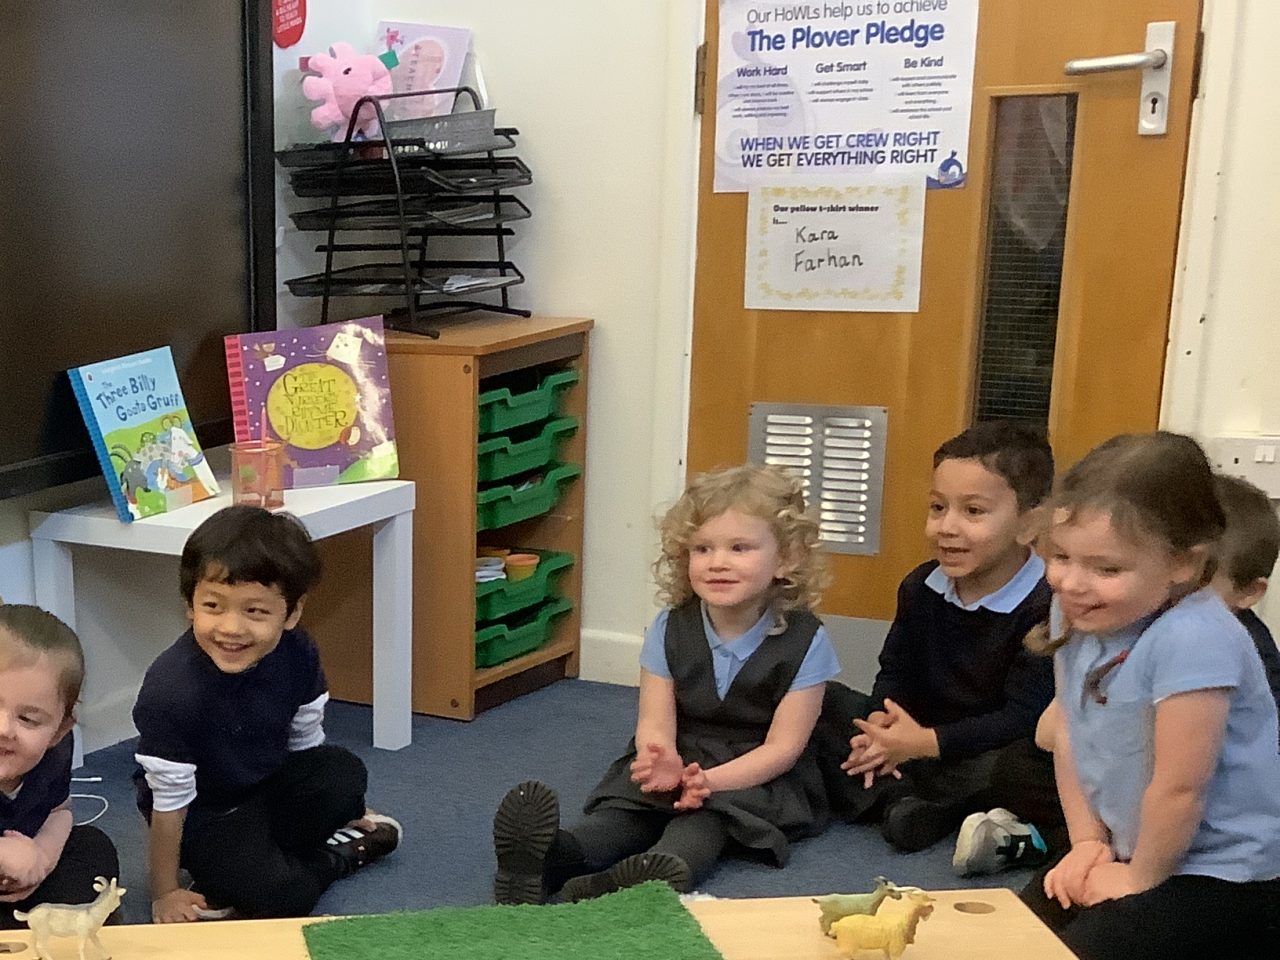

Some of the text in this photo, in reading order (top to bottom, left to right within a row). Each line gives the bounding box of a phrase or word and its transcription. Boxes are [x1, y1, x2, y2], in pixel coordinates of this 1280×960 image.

[747, 0, 948, 24] Our HoWLs help us to achieve
[747, 18, 945, 52] The Plover Pledge
[736, 65, 789, 78] Work Hard
[815, 61, 867, 74] Get Smart
[903, 56, 945, 69] Be Kind
[740, 131, 941, 151] WHEN WE GET CREW RIGHT
[741, 148, 938, 168] WE GET EVERYTHING RIGHT
[773, 203, 879, 214] Our yellow t-shirt winner
[795, 226, 839, 243] Kara
[794, 247, 863, 272] Farhan
[95, 374, 156, 409] Three Billy
[116, 393, 179, 421] Goats Gruff
